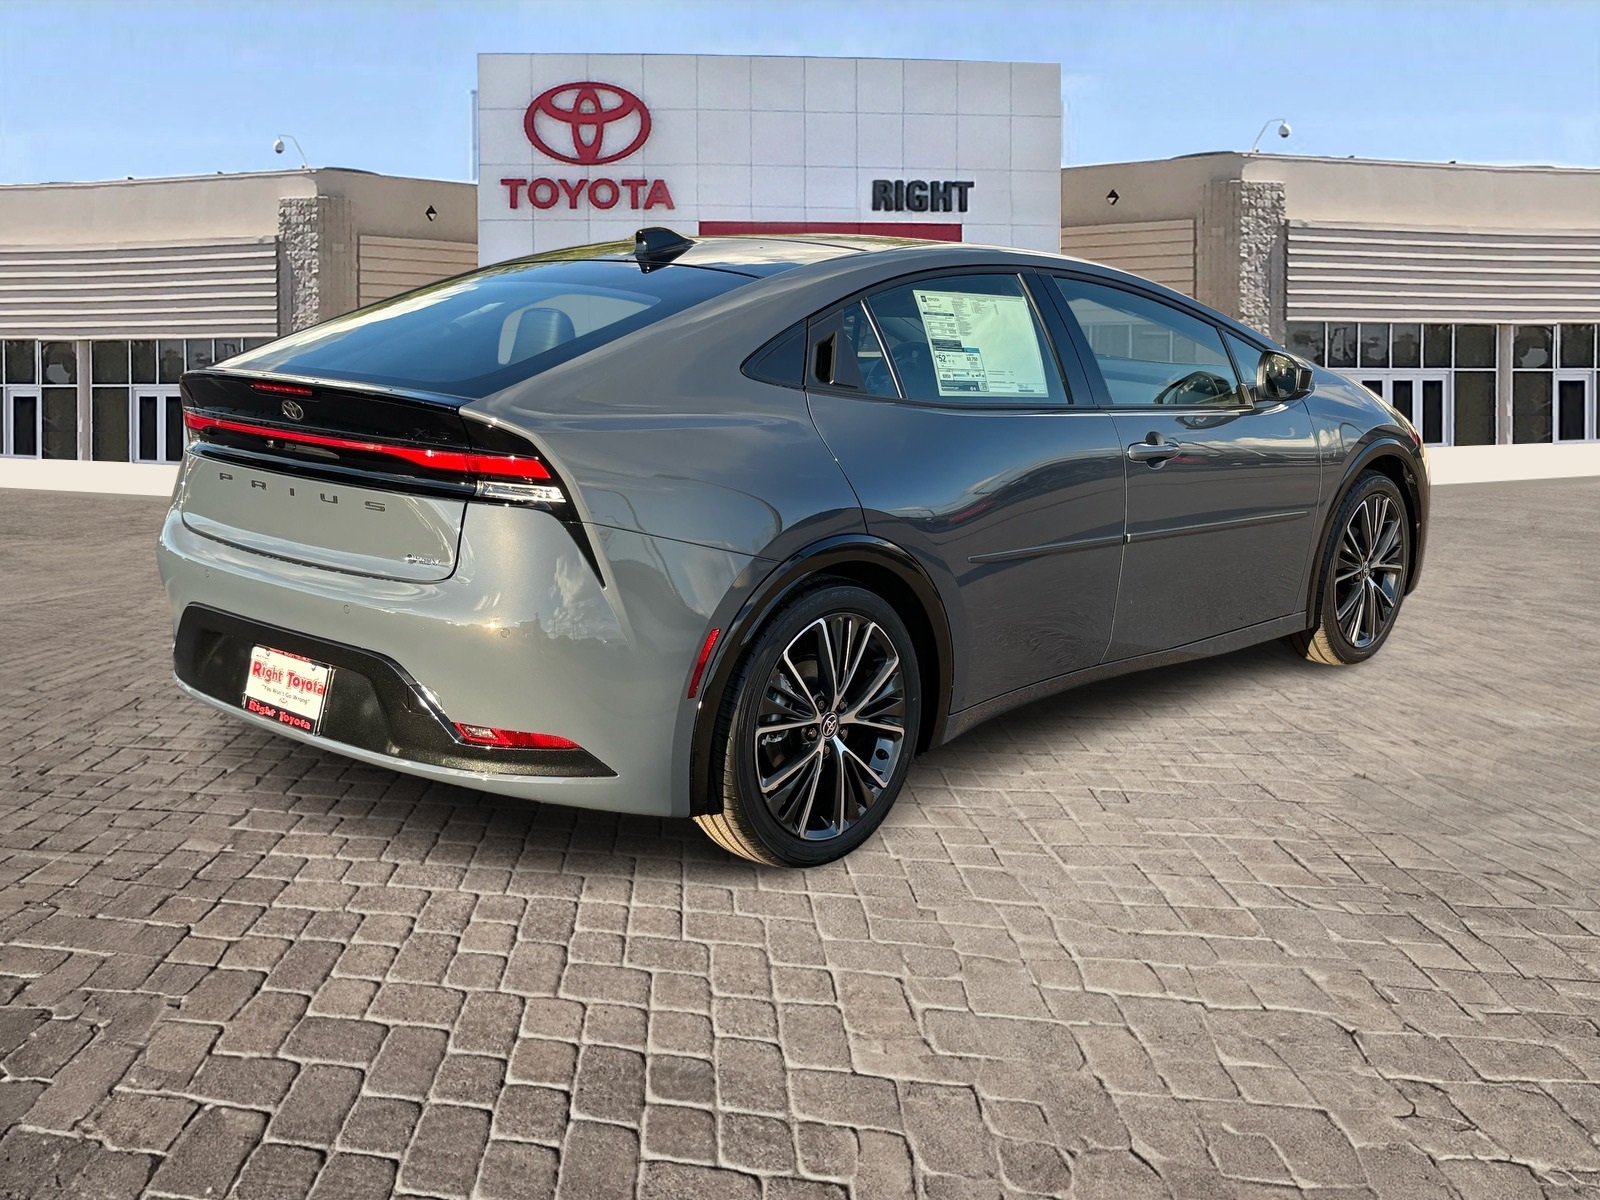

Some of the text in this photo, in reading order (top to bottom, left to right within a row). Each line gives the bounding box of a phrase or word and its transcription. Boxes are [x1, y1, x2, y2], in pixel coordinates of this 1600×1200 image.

[500, 178, 675, 211] TOYOTA
[871, 178, 976, 213] RIGHT
[219, 472, 386, 512] PRIUS
[252, 660, 325, 696] Right Toyota
[248, 699, 311, 730] Right Toyota
